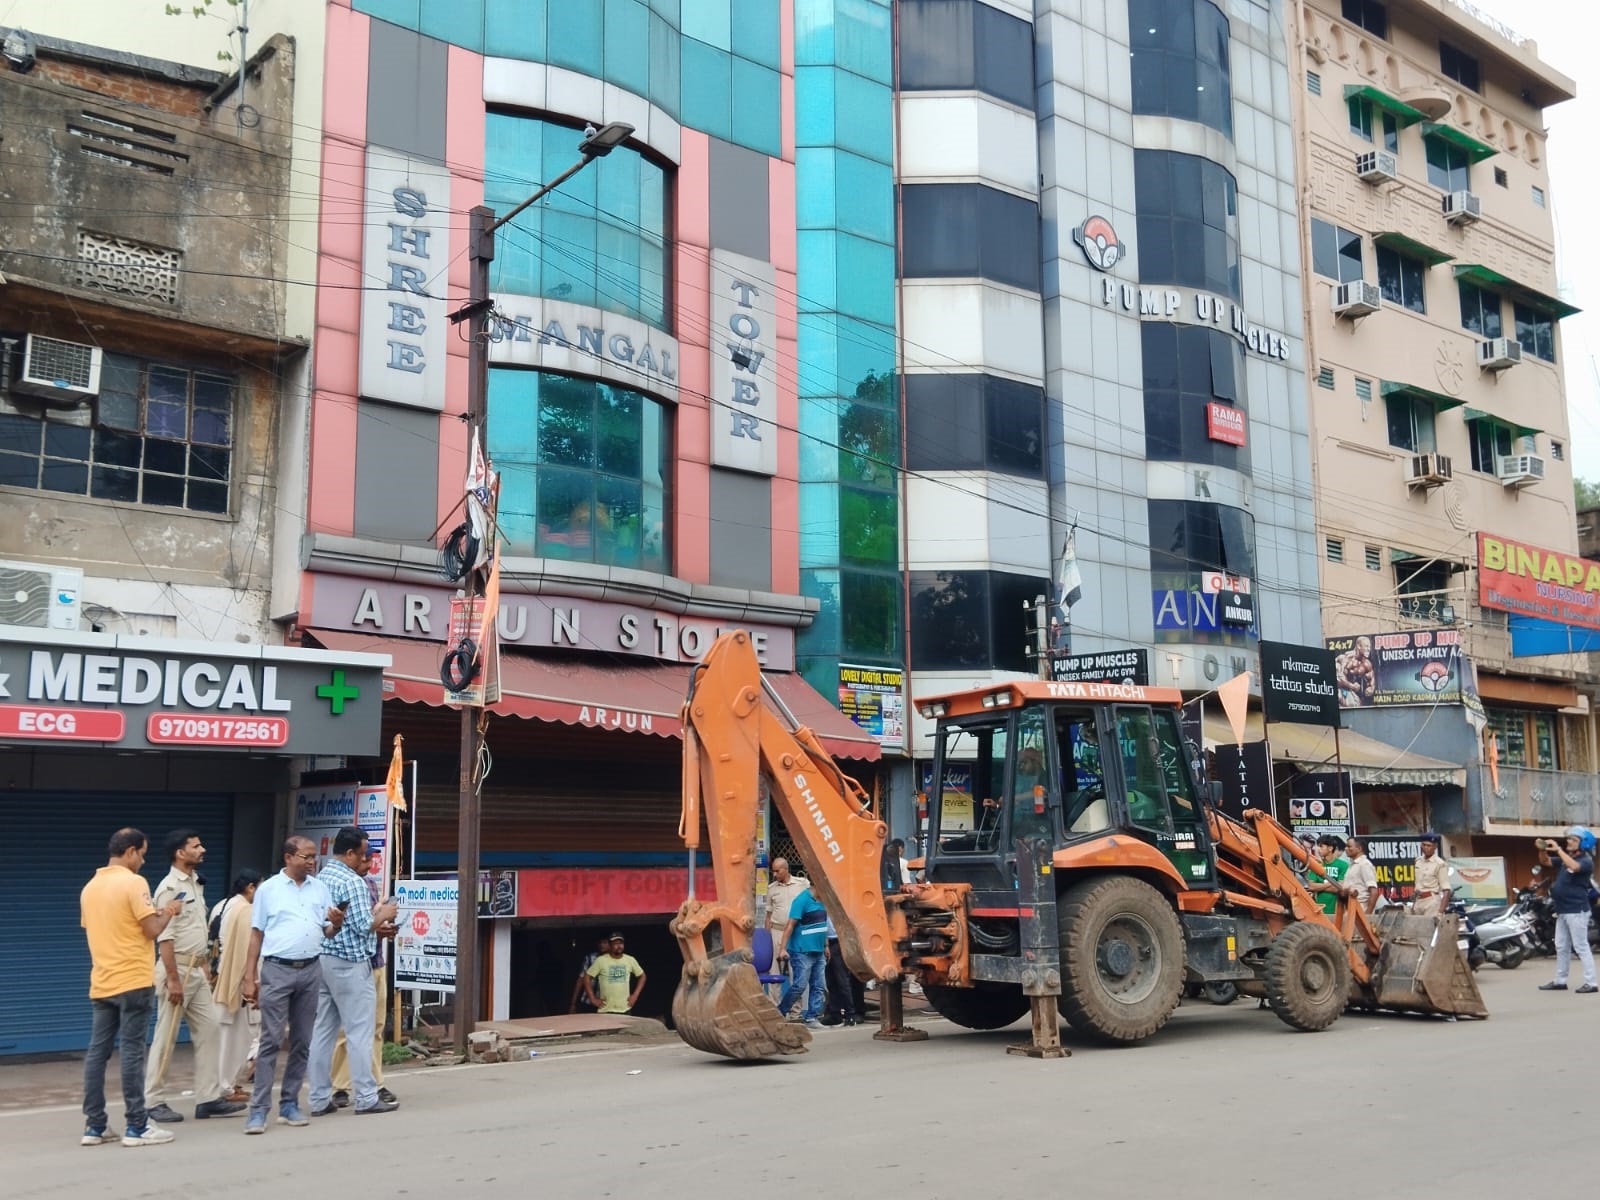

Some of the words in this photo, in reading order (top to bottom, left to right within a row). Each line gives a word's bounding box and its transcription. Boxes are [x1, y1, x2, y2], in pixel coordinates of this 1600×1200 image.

[387, 187, 432, 375] SHREE
[1103, 278, 1181, 316] PUMP
[1196, 294, 1225, 323] UP
[492, 314, 676, 381] MANGAL
[727, 279, 765, 442] TOWER
[1212, 406, 1242, 424] RAMA
[1210, 575, 1248, 593] OPEN
[1536, 582, 1595, 608] NURSING
[1225, 606, 1253, 622] ANKUR
[352, 588, 581, 647] ARUN
[618, 613, 768, 666] STOE
[1374, 634, 1410, 650] PUMP
[1414, 632, 1432, 647] UP
[1054, 659, 1080, 673] PUMP
[1081, 657, 1094, 670] UP
[1096, 652, 1138, 668] MUSCLES
[1382, 649, 1414, 662] UNISEX
[1416, 647, 1448, 661] FAMILY
[1057, 672, 1081, 682] UNISEX
[1081, 669, 1105, 680] FAMILY
[1106, 668, 1119, 678] A/C
[1120, 667, 1136, 677] GYM
[1282, 656, 1320, 675] inkmaze
[28, 651, 292, 712] MEDICAL
[841, 669, 861, 683] LOVELY
[861, 670, 883, 684] DIGITAL
[882, 672, 902, 686] STUDIO
[1269, 674, 1302, 692] tattoo
[1305, 678, 1334, 696] studio
[1047, 683, 1088, 698] TATA
[1089, 684, 1145, 700] HITACHI
[18, 711, 76, 734] ECG
[578, 704, 653, 731] ARJUN
[158, 718, 280, 741] 9709172561
[793, 773, 845, 863] SHINRAI
[1368, 841, 1399, 860] SMILE
[407, 886, 428, 900] modi
